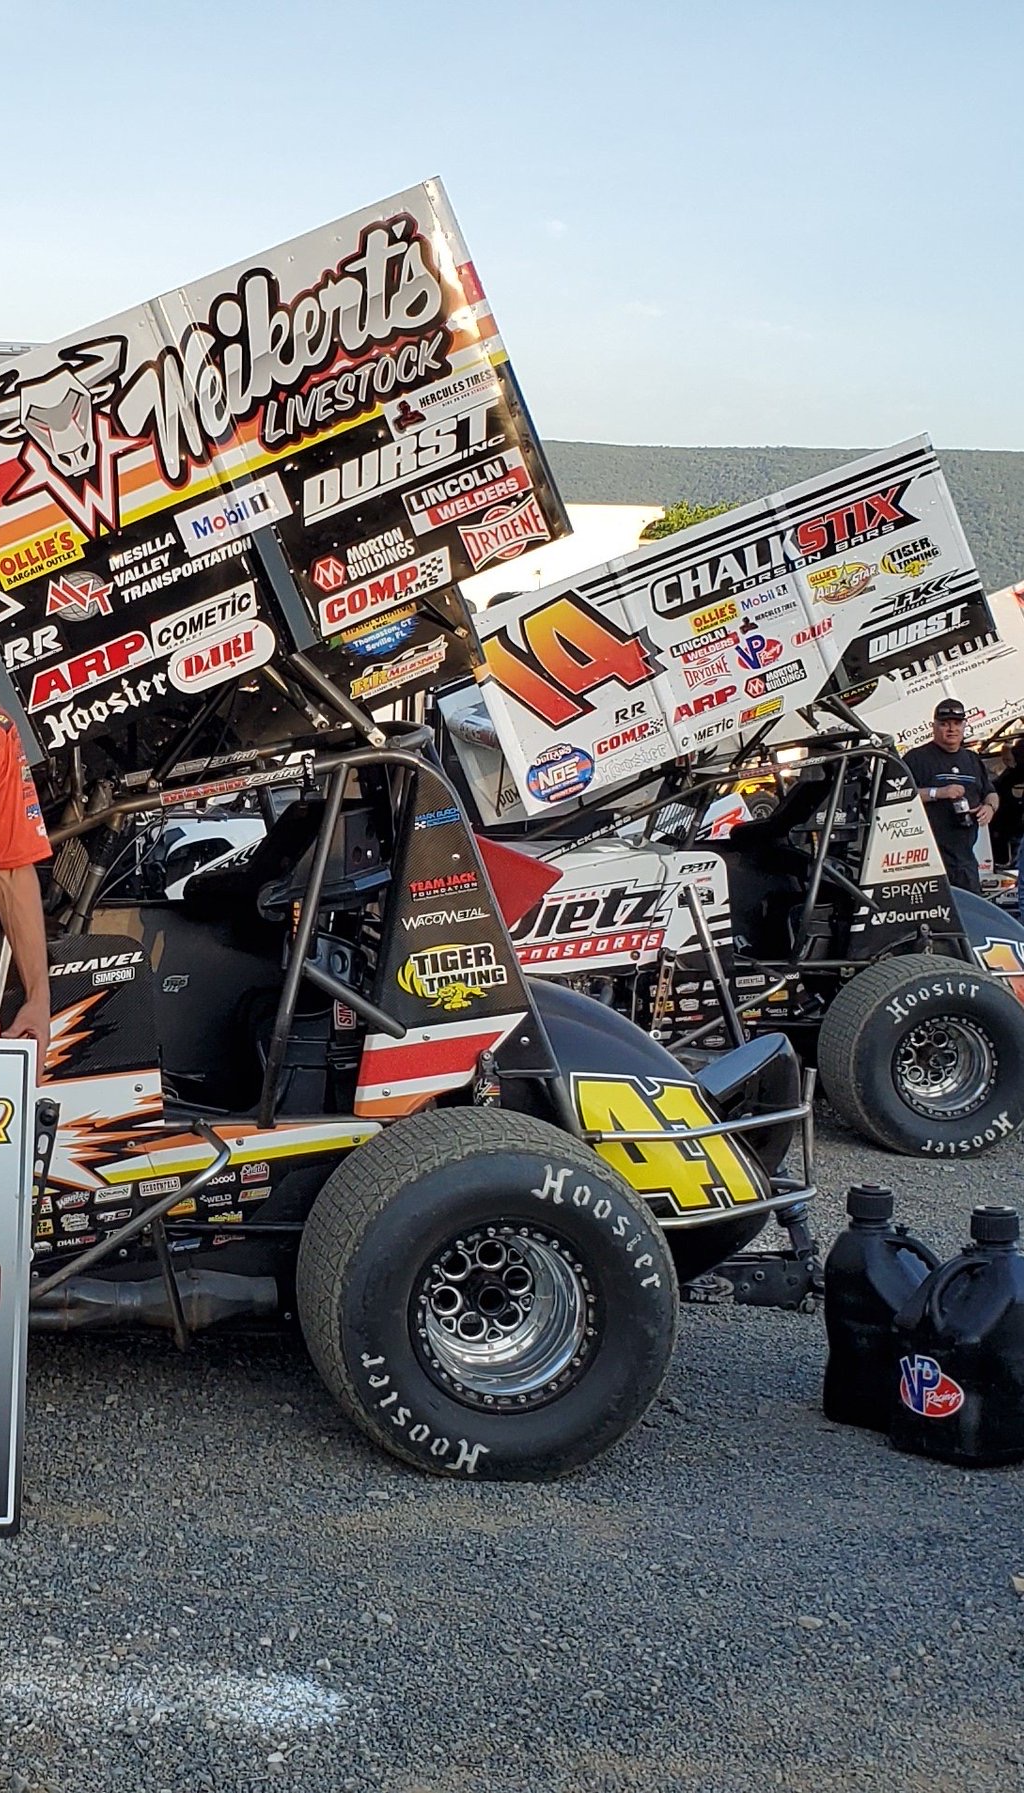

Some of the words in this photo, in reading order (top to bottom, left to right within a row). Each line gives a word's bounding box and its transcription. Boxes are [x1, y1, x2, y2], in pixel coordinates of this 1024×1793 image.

[119, 220, 440, 478] Weikert's
[265, 332, 443, 443] LIVESTOCK
[419, 381, 465, 408] HERCULES
[466, 370, 492, 387] TIRES
[304, 405, 491, 516] DURST
[462, 433, 506, 459] INC
[410, 461, 502, 512] LINCOLN
[438, 477, 519, 520] WELDERS
[191, 505, 250, 540] Mobil
[465, 507, 546, 566] DRYDENE
[109, 531, 176, 571] MESILLA
[346, 526, 406, 562] MORTON
[346, 539, 416, 581] BUILDINGS
[729, 551, 822, 594] TORSION
[836, 523, 896, 553] BARS
[887, 536, 931, 562] TIGER
[896, 549, 940, 571] TOWING
[6, 563, 45, 586] BARGAIN
[46, 549, 77, 573] OUTLET
[114, 553, 170, 588] VALLEY
[120, 537, 252, 604] TRANSPORTATION
[326, 565, 419, 624] COMP
[393, 575, 439, 602] CAMS
[741, 589, 775, 611] Mobil
[156, 591, 252, 646] COMETIC
[869, 603, 967, 657] DURST
[948, 619, 970, 632] INC
[671, 628, 727, 656] LINCOLN
[687, 637, 735, 662] WELDERS
[735, 634, 766, 669] VP
[32, 633, 146, 706] ARP
[474, 592, 662, 730] 14
[684, 655, 731, 689] DRYDENE
[766, 661, 798, 682] MORTON
[766, 669, 806, 692] BUILDINGS
[44, 671, 167, 750] Hoosier
[615, 701, 646, 725] RR
[674, 685, 738, 724] ARP
[596, 722, 650, 756] COMP
[882, 848, 929, 868] ALL-PRO
[410, 878, 445, 893] TEAM
[446, 871, 476, 884] JACK
[413, 882, 478, 898] FOUNDATION
[48, 950, 144, 977] GRAVEL
[95, 968, 132, 984] SIMPSON
[413, 944, 495, 977] TIGER
[426, 966, 507, 996] TOWING
[886, 978, 979, 1025] Hoosier
[574, 1076, 761, 1212] 41
[921, 1111, 1013, 1154] Hoosier
[530, 1163, 662, 1289] Hoosier
[899, 1354, 941, 1413] VP
[925, 1387, 962, 1409] Racing
[360, 1349, 494, 1474] Hoosier
